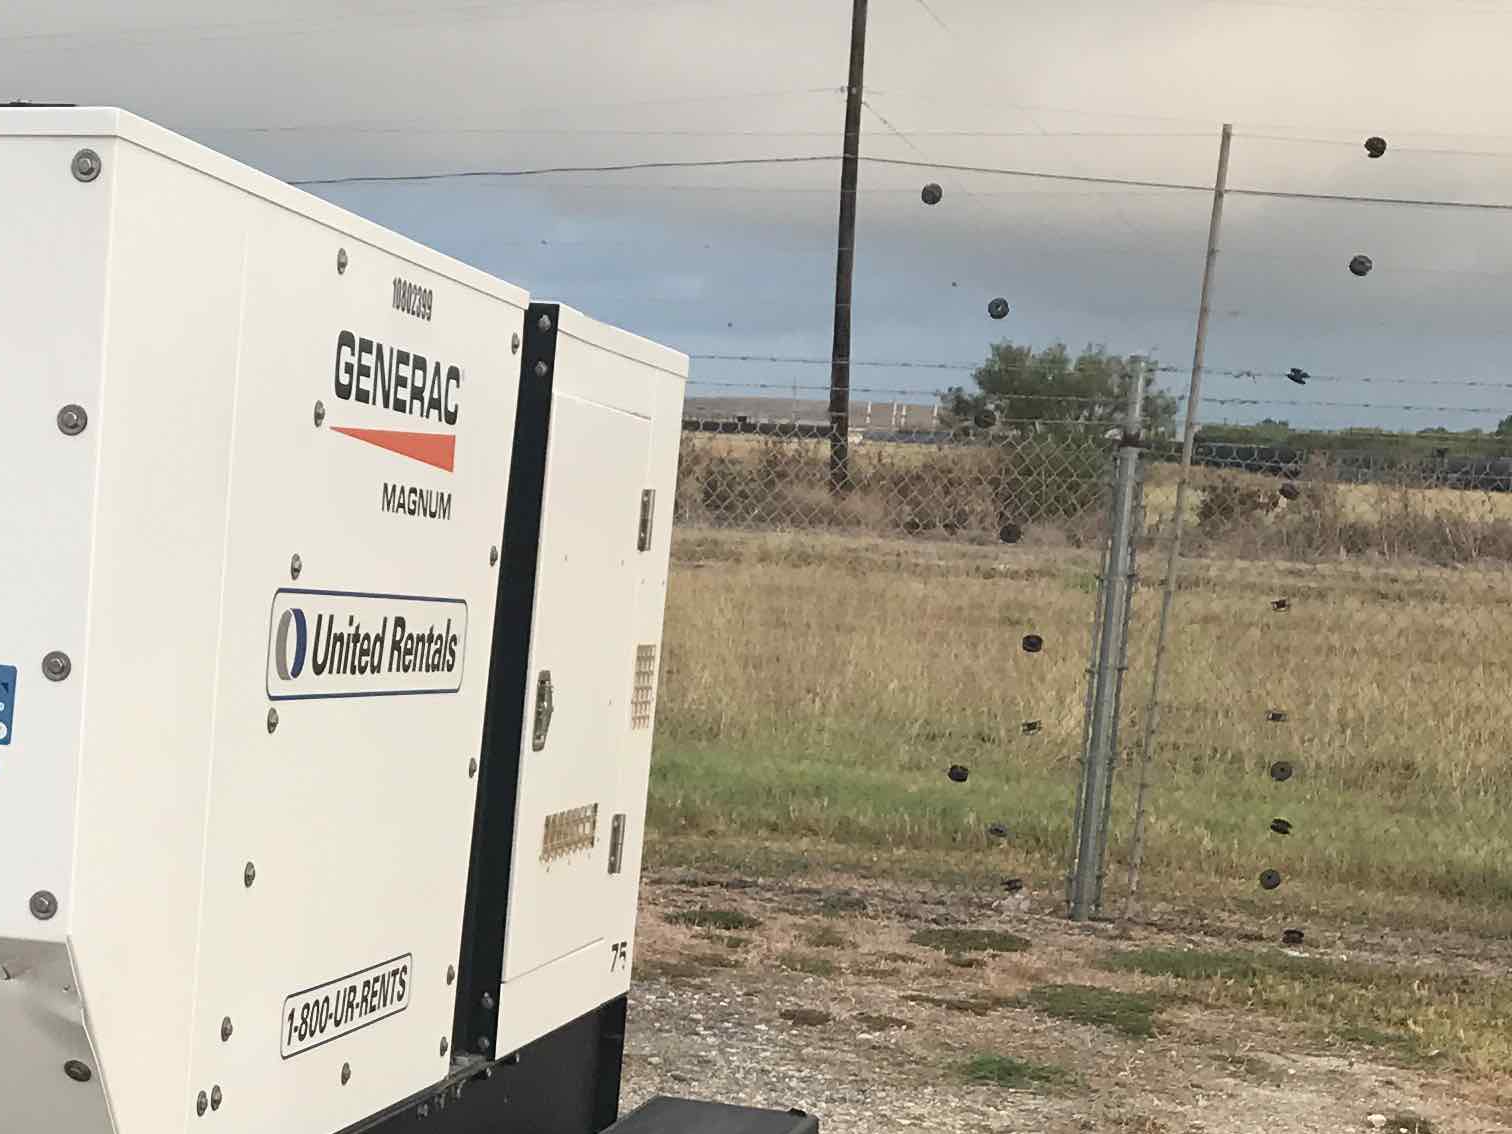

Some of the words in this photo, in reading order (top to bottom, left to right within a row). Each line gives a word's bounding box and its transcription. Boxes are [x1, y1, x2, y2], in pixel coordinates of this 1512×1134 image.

[392, 277, 433, 321] 10802399
[334, 330, 460, 426] GENERAC
[382, 482, 452, 521] MAGNUM
[312, 614, 387, 676] United
[388, 616, 458, 674] Rentals
[287, 965, 409, 1046] 1-800-UR-RENTS
